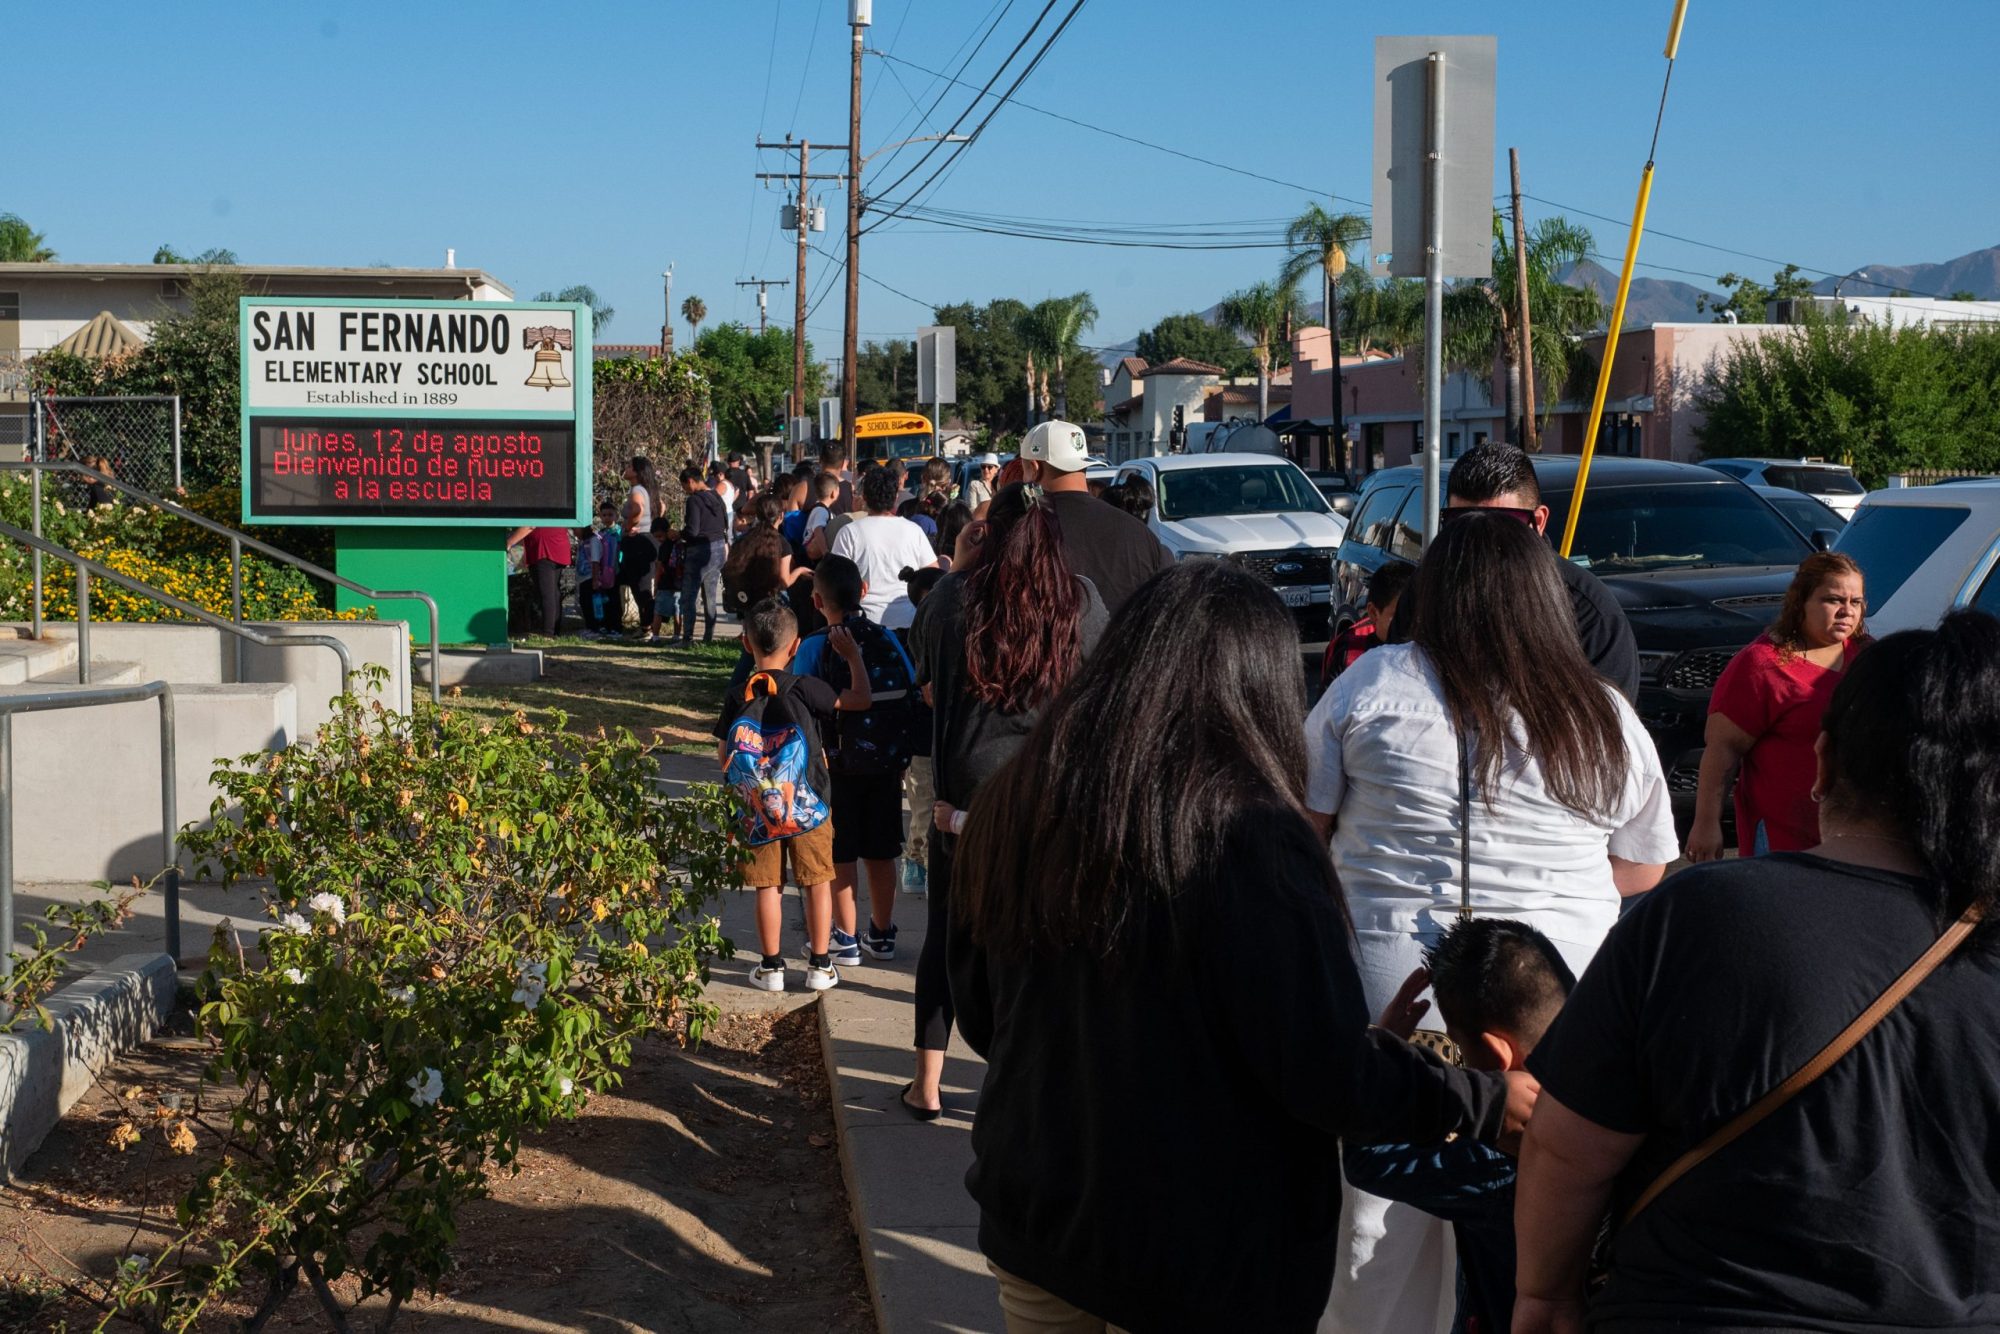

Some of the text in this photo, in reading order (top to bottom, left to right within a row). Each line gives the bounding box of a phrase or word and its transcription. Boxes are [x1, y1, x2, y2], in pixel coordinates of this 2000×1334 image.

[253, 311, 510, 355] SAN FERNANDO
[265, 360, 498, 386] ELEMENTARY SCHOOL
[306, 390, 458, 406] Established in 1889
[867, 421, 904, 432] SCHOOL BUS
[283, 428, 542, 458] lunes, 12 de agosto
[274, 451, 418, 476] Bienvenido
[427, 454, 458, 477] de
[335, 476, 493, 500] a la escuela
